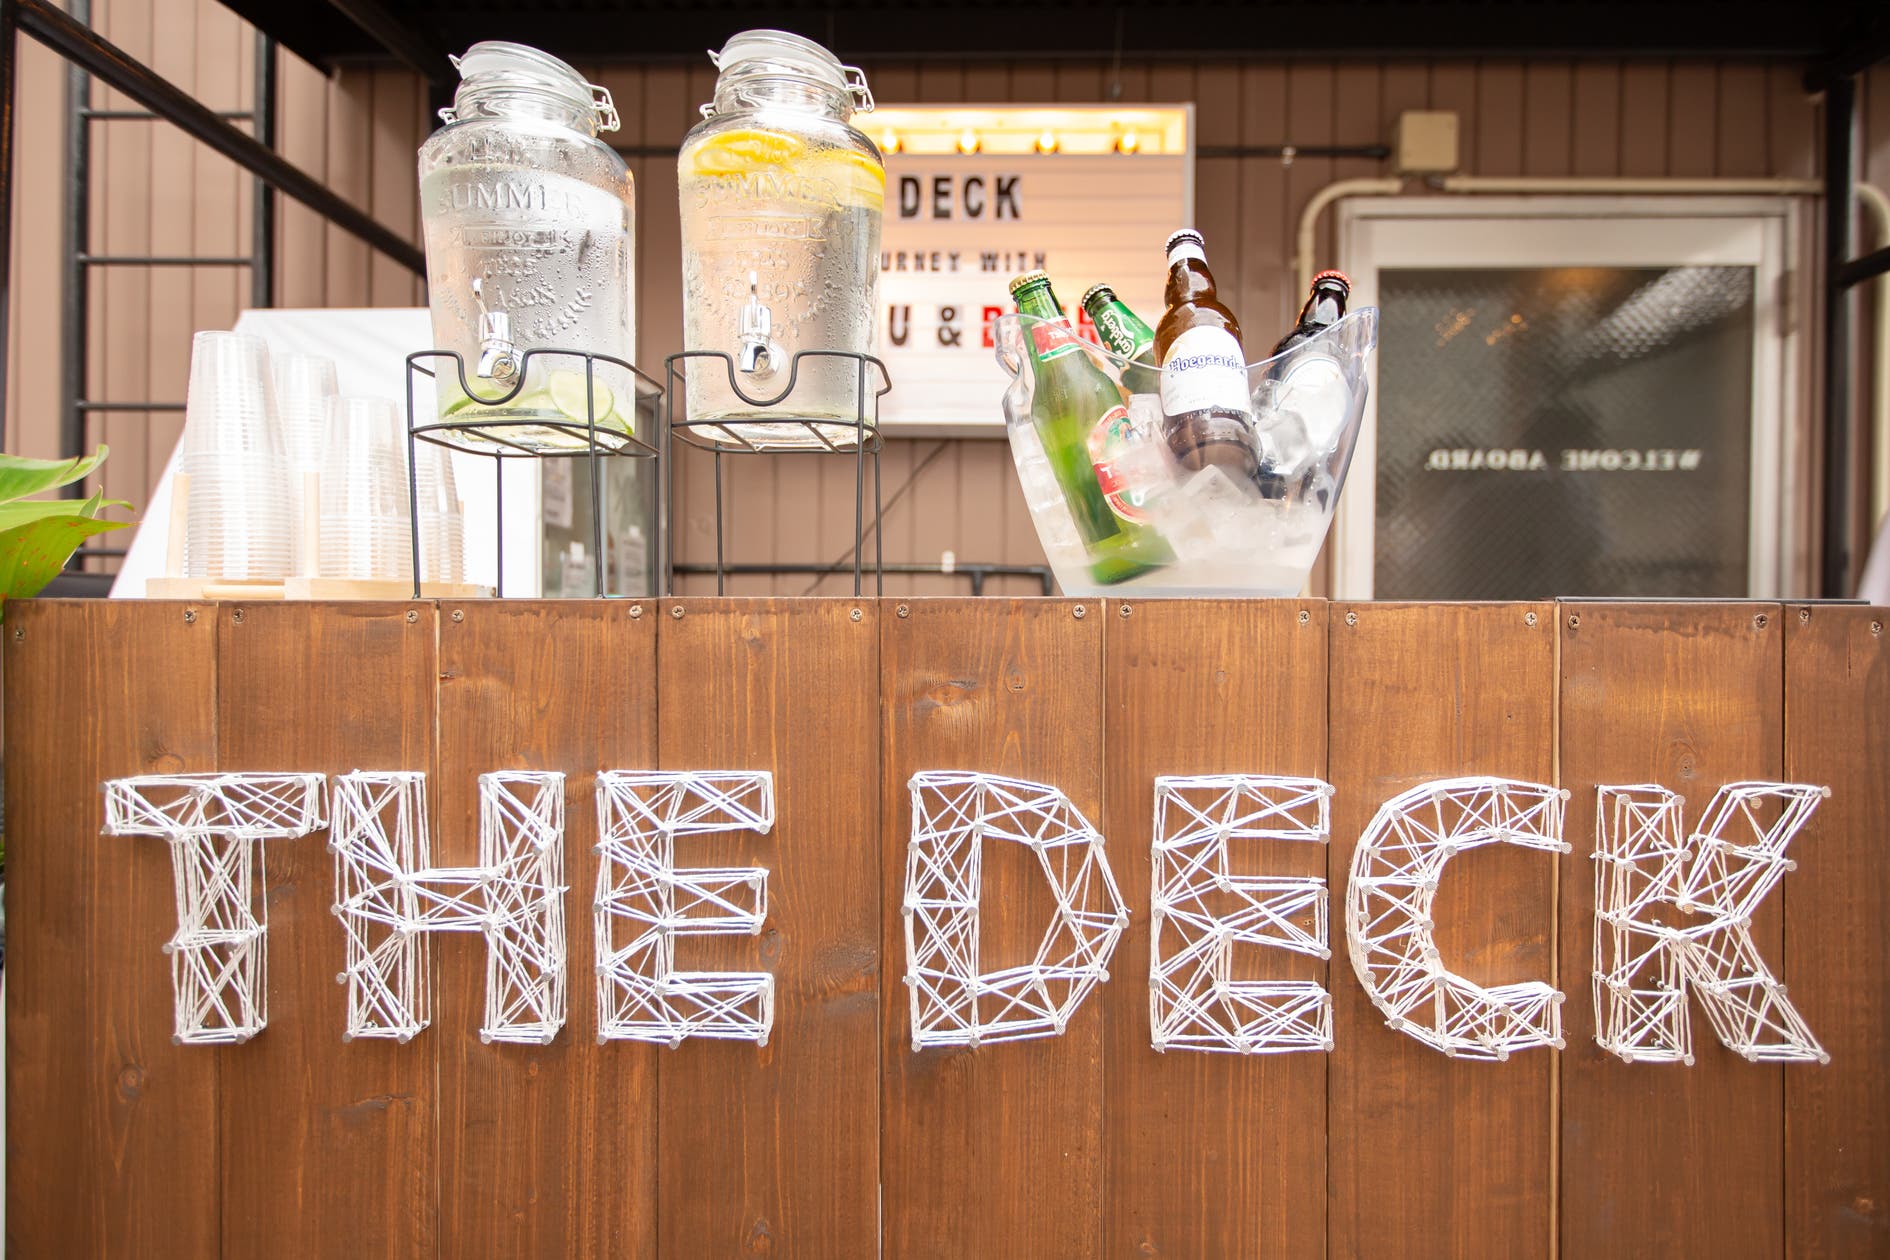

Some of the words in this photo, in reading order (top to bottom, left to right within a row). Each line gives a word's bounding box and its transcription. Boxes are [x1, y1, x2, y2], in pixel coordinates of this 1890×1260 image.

[899, 176, 1021, 219] DECK
[881, 252, 960, 272] URNEY
[980, 252, 1047, 272] WITH
[937, 306, 961, 347] &
[1101, 309, 1136, 360] Carlsberg
[102, 768, 775, 1046] THE
[902, 769, 1831, 1064] DECK
